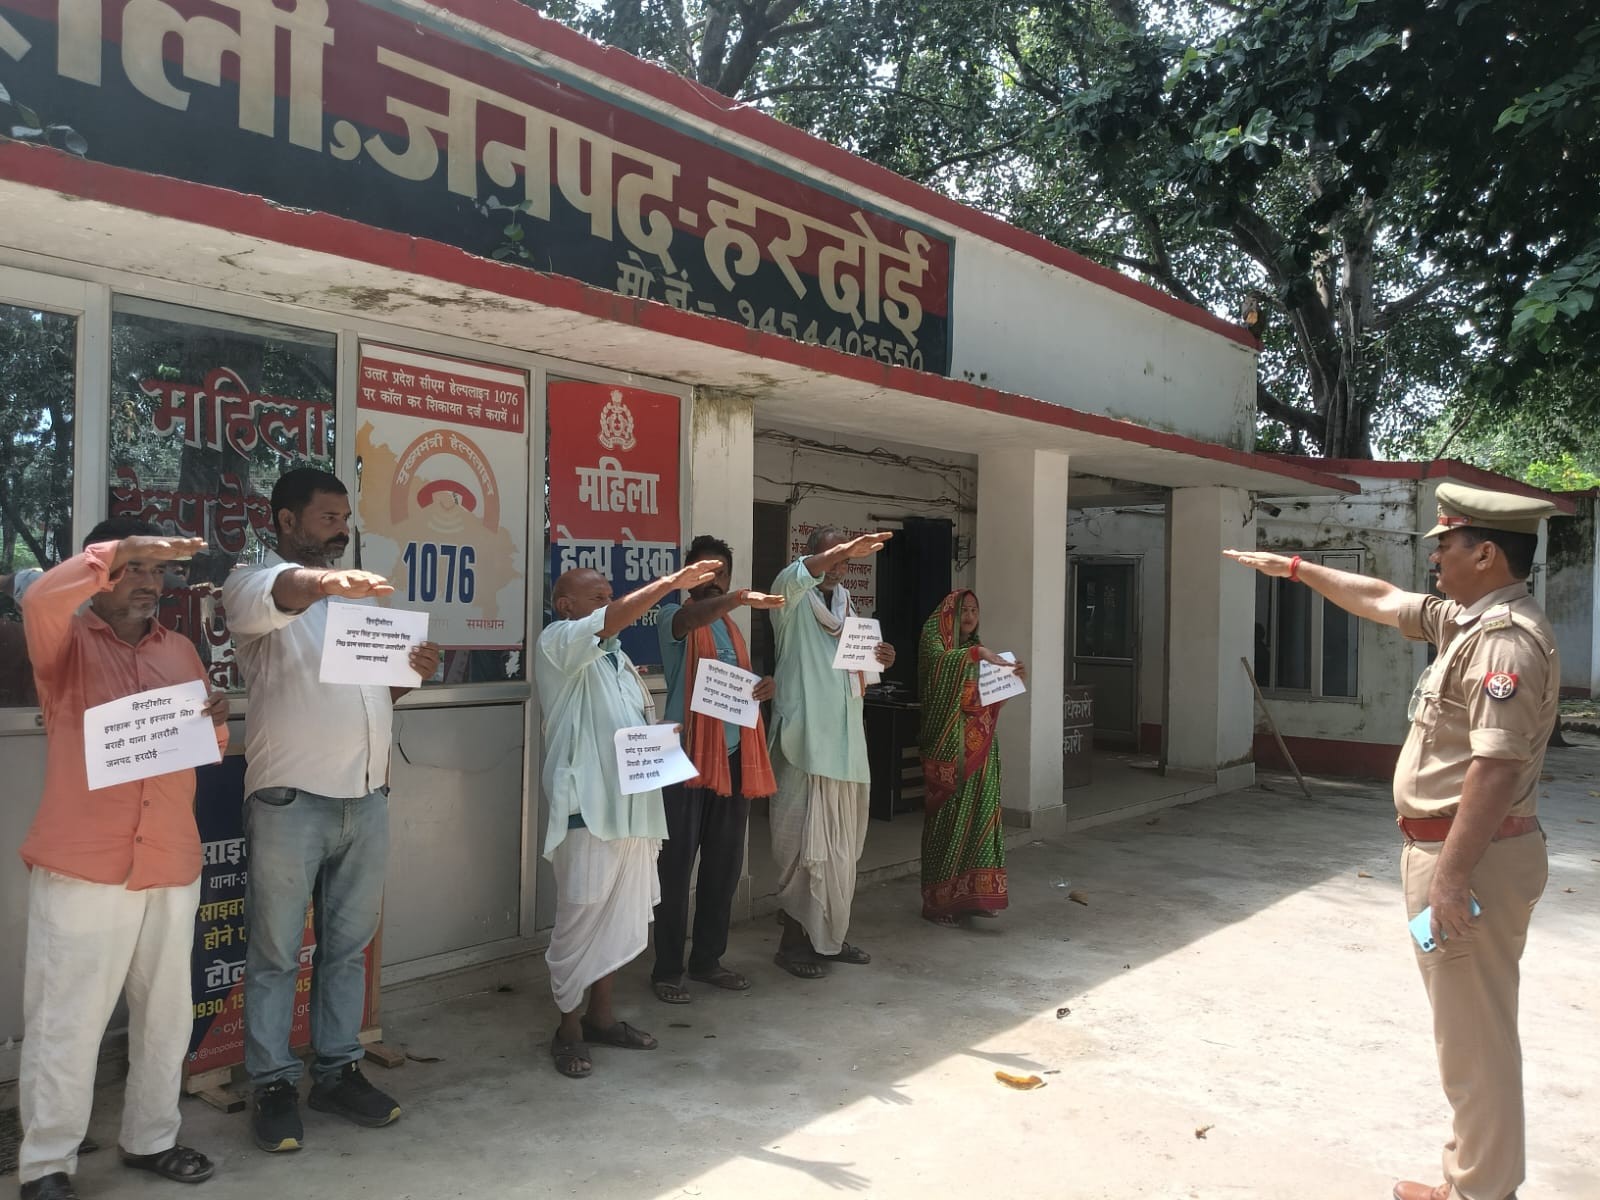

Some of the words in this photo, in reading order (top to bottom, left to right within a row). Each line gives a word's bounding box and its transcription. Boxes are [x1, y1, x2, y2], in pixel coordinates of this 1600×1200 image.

[364, 366, 388, 383] उत्तर
[392, 369, 415, 387] प्रदेश
[419, 374, 445, 393] सीएम
[449, 379, 490, 400] हेल्पलाइन
[494, 389, 519, 406] 1076
[140, 366, 333, 462] महिला
[362, 387, 376, 401] पर
[380, 388, 402, 405] कॉल
[407, 395, 422, 408] कर
[426, 395, 462, 416] शिकायत
[576, 457, 660, 516] महिला
[403, 542, 475, 604] 1076
[132, 697, 172, 711] हिस्ट्रीशीटर
[129, 734, 146, 745] थाना
[150, 728, 179, 741] अतरौली
[135, 718, 146, 730] पुत्र
[106, 755, 131, 768] जनपद
[134, 748, 158, 764] हरदोई
[203, 925, 233, 950] होने
